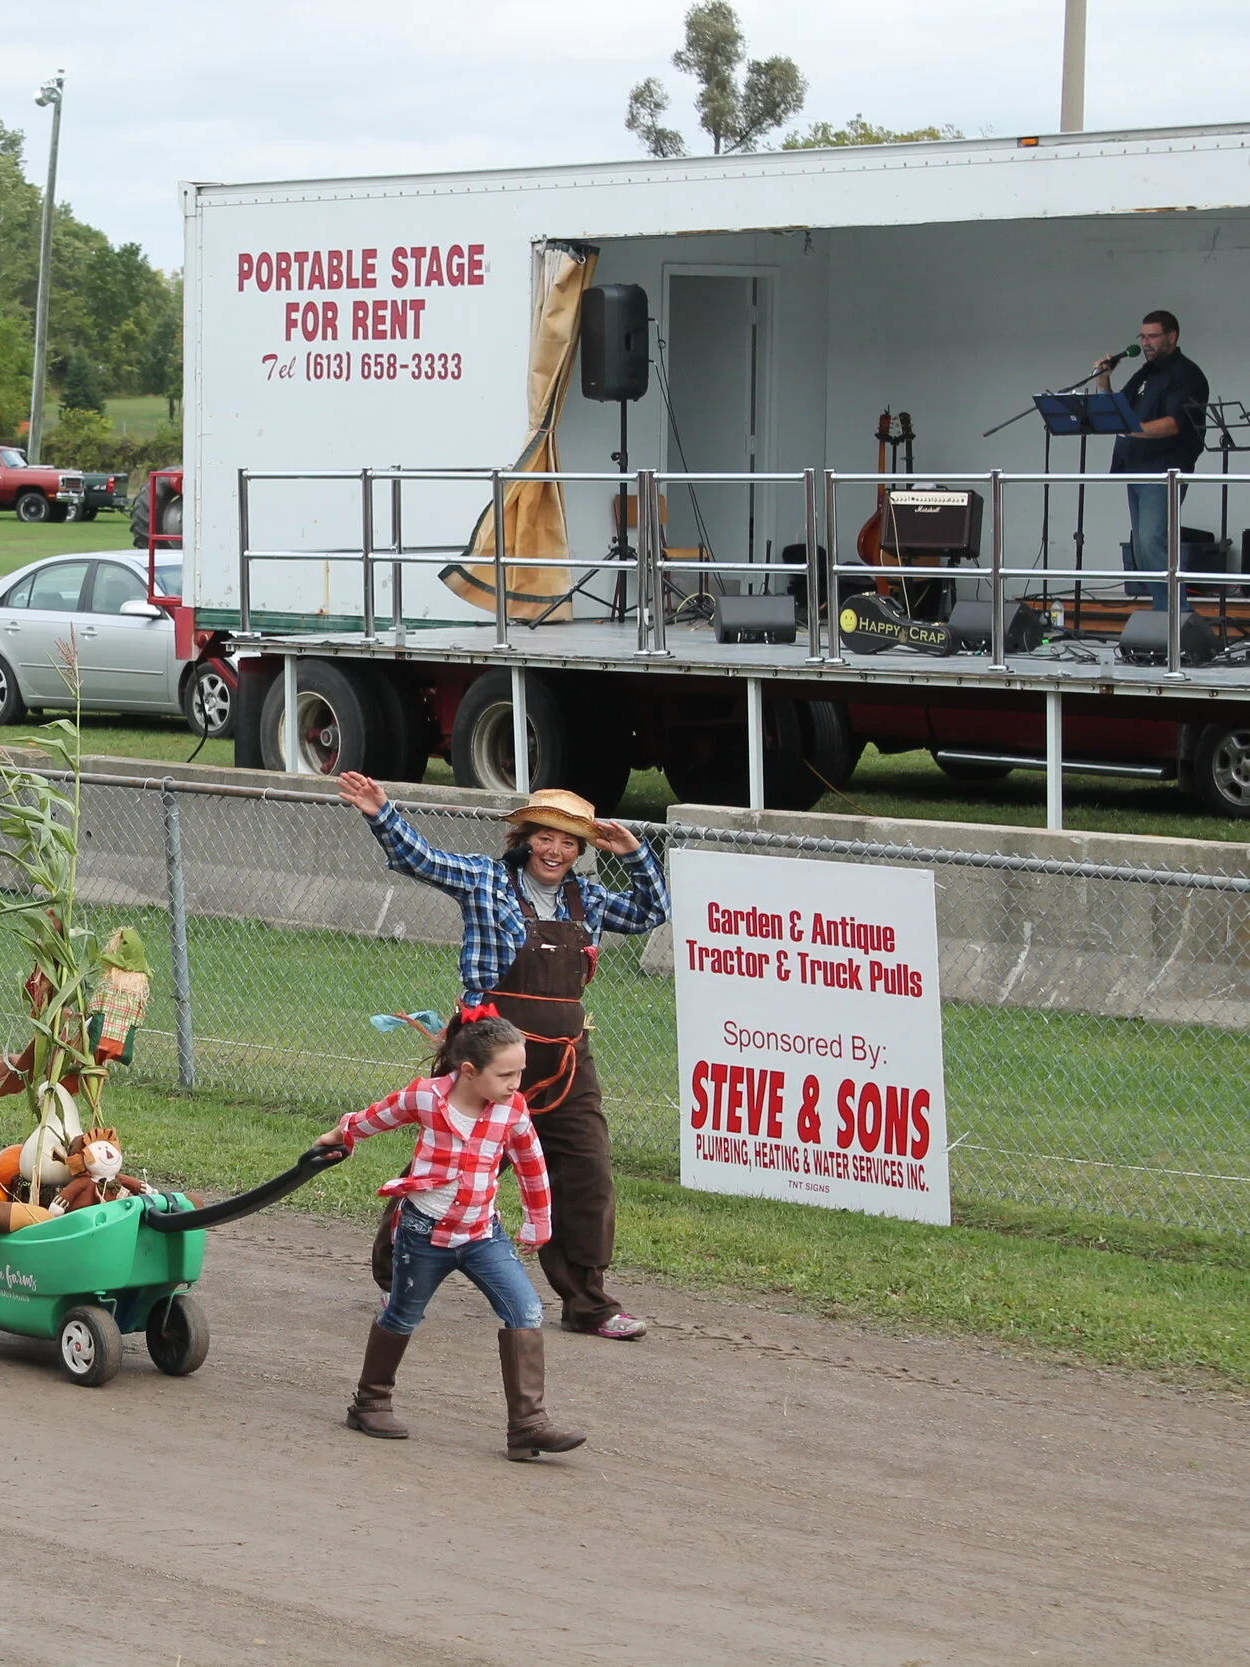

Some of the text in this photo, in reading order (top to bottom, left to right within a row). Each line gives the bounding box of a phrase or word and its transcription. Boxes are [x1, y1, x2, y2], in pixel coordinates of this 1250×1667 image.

[238, 244, 485, 292] PORTABLE STAGE
[285, 298, 425, 342] FOR RENT
[261, 352, 462, 382] Tel (613) 658-3333
[859, 617, 946, 644] HAPPY CRAP
[707, 902, 895, 955] Garden & Antique
[686, 939, 923, 998] Tractor & Truck Pulls
[723, 1020, 887, 1069] Sponsored By:
[691, 1060, 930, 1160] STEVE & SONS
[696, 1134, 930, 1192] PLUMBING, HEATING & WATER SERVICES INC.
[788, 1180, 830, 1193] TNT SIGNS
